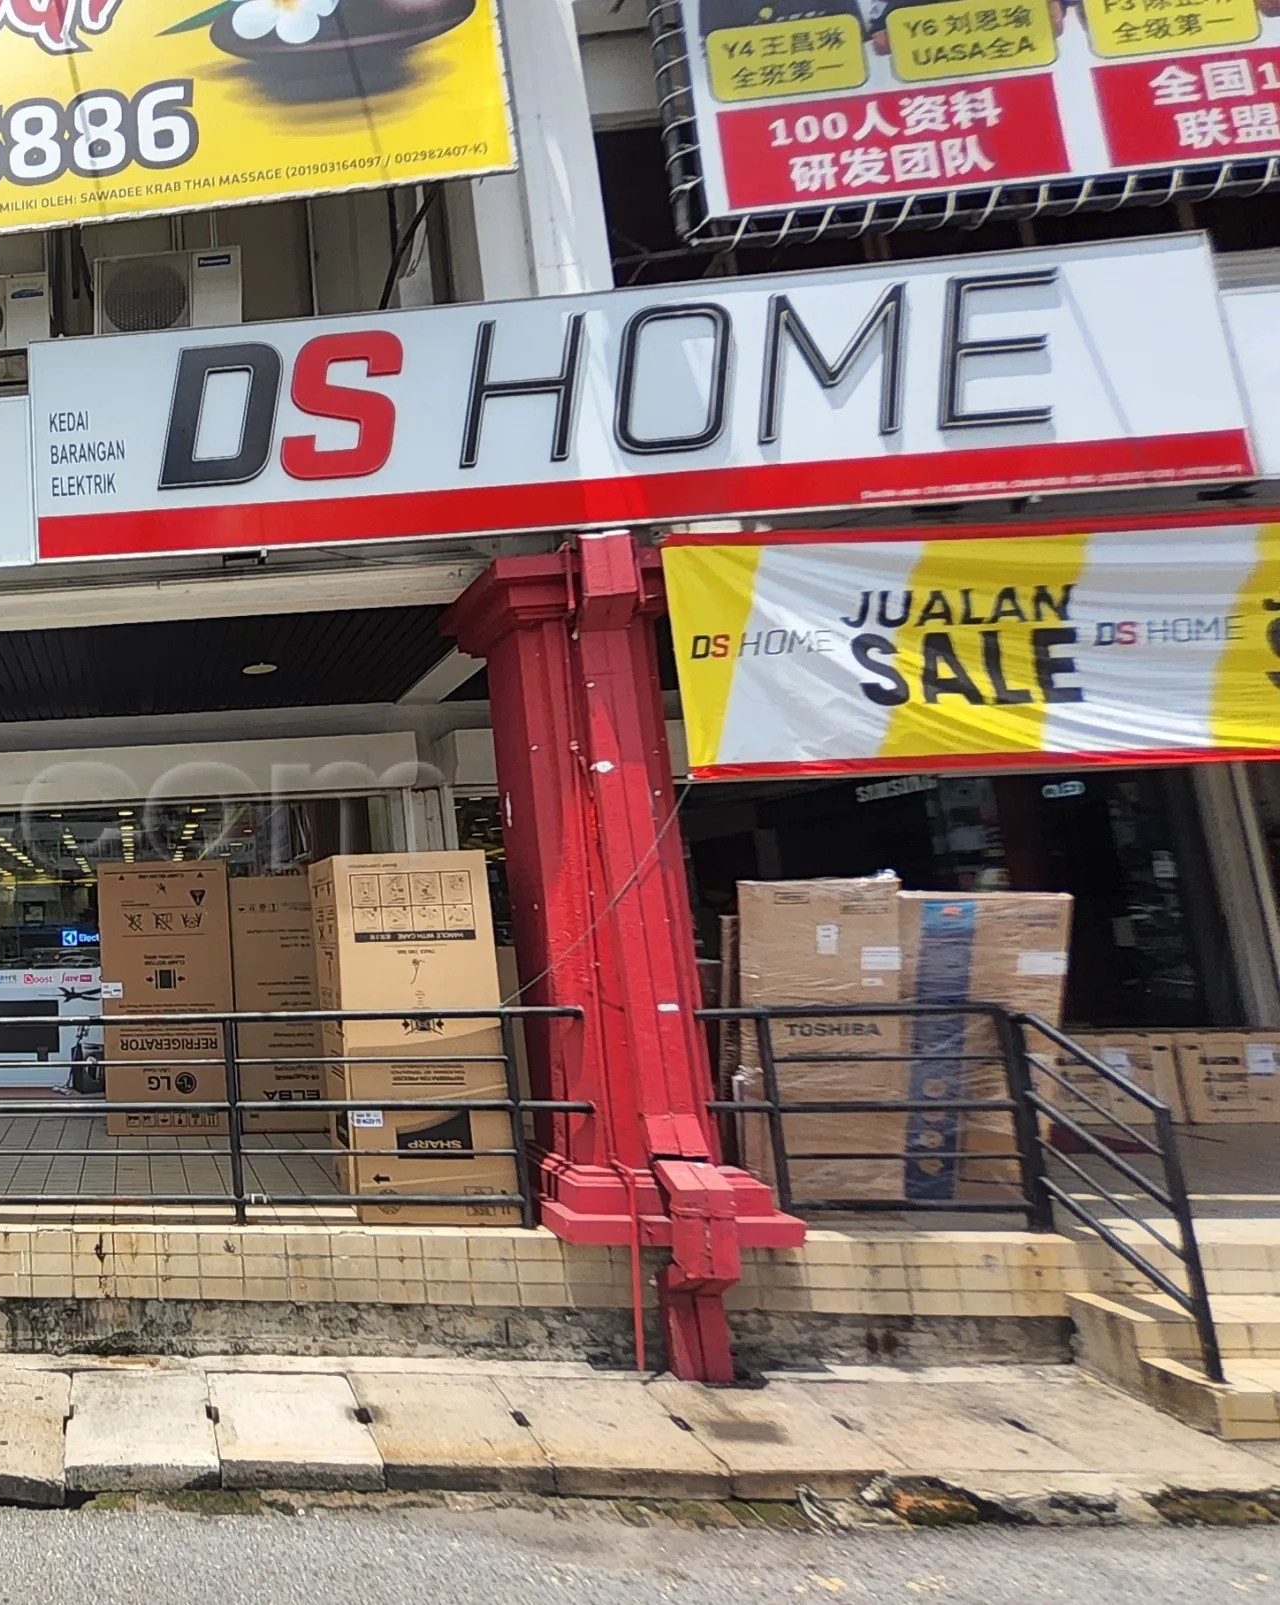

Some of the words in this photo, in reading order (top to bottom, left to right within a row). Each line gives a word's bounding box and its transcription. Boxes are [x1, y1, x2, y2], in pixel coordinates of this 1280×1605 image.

[903, 18, 939, 38] Y6
[768, 87, 1003, 148] 100人资料
[1173, 102, 1280, 150] 联盟
[788, 134, 995, 193] 研发团队
[41, 194, 78, 208] OLEH:
[80, 185, 142, 204] SAWADEE
[146, 180, 182, 196] KRAB
[184, 175, 216, 192] THAI
[219, 167, 282, 186] MASSAGE
[285, 154, 382, 180] (201903164097
[158, 329, 404, 490] DS
[459, 266, 1061, 470] HOME
[49, 410, 90, 434] KEDAI
[50, 438, 126, 465] BARANGAN
[51, 472, 117, 498] ELEKTRIK
[839, 582, 1078, 629] JUALAN
[690, 633, 730, 660] DS
[738, 628, 834, 658] HOME
[1093, 620, 1138, 647] DS
[1146, 614, 1247, 645] HOME
[850, 626, 1086, 707] SALE
[120, 1037, 218, 1051] REFRIGERATOR
[783, 1022, 882, 1037] TOSHIBA
[147, 1075, 172, 1091] LG
[262, 1089, 321, 1101] ELBA
[407, 1139, 462, 1149] SHARP
